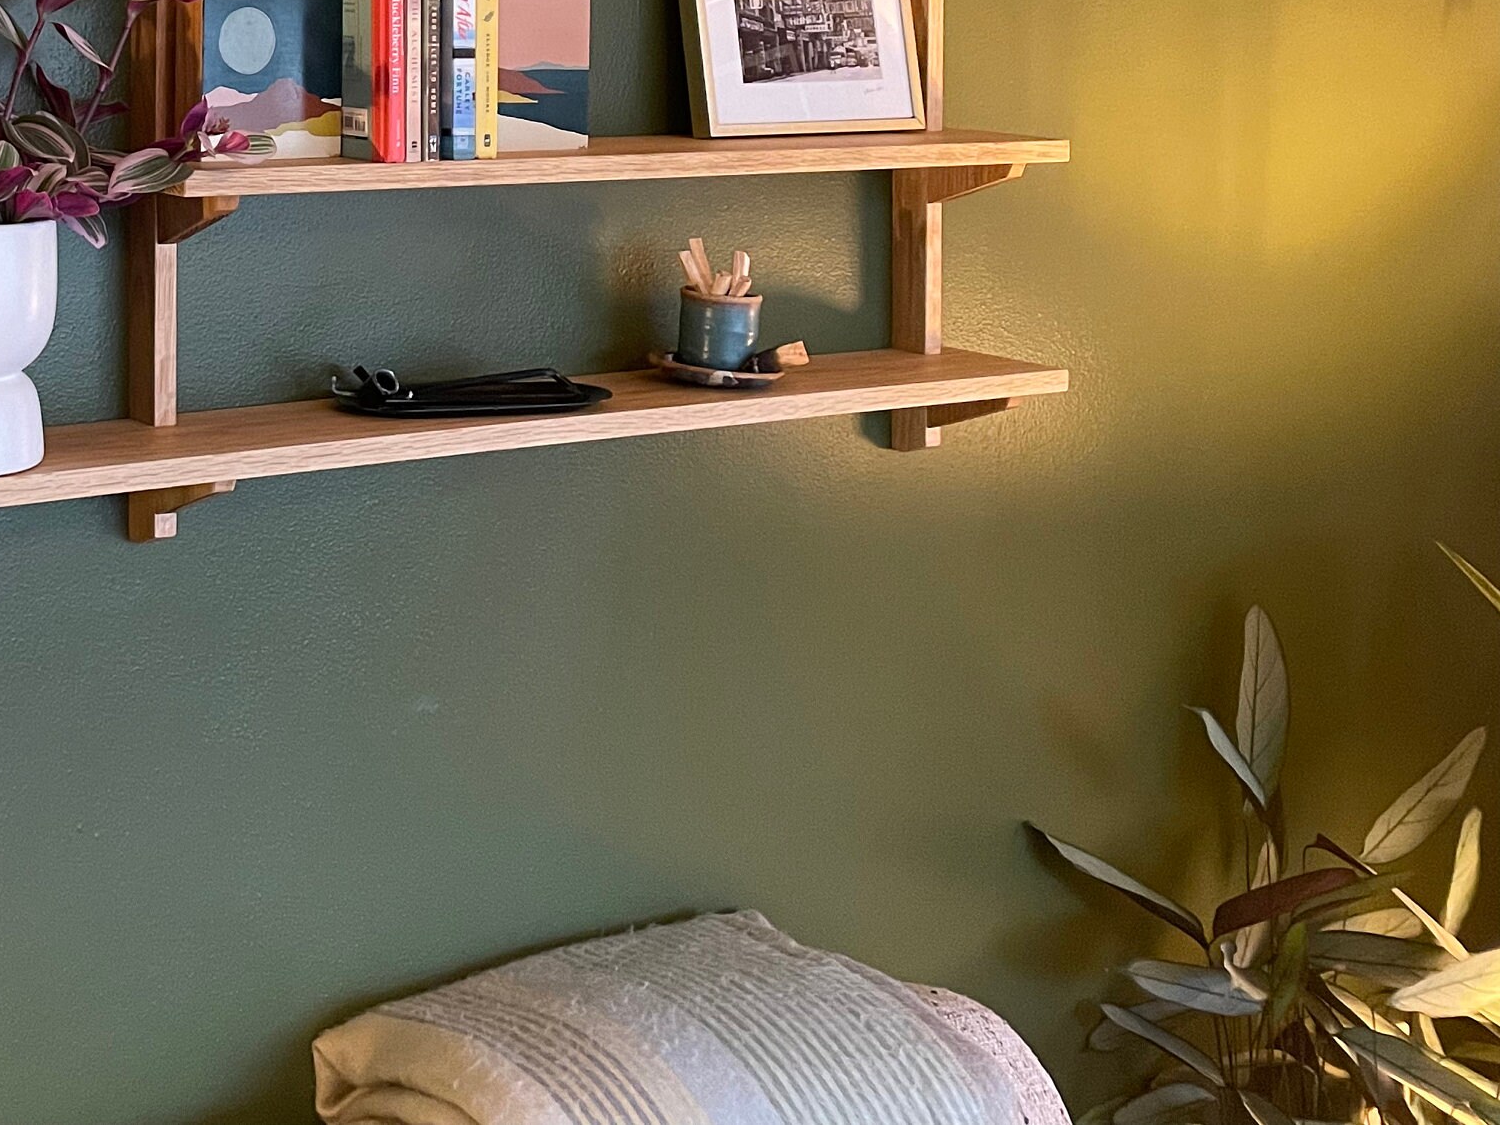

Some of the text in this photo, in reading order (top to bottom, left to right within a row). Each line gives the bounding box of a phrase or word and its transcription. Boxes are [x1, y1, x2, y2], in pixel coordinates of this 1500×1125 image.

[411, 1, 419, 22] THE
[455, 6, 473, 40] After
[429, 35, 439, 65] MILES
[392, 67, 401, 94] Finn
[430, 71, 437, 83] TO
[455, 68, 463, 115] FORTUNE
